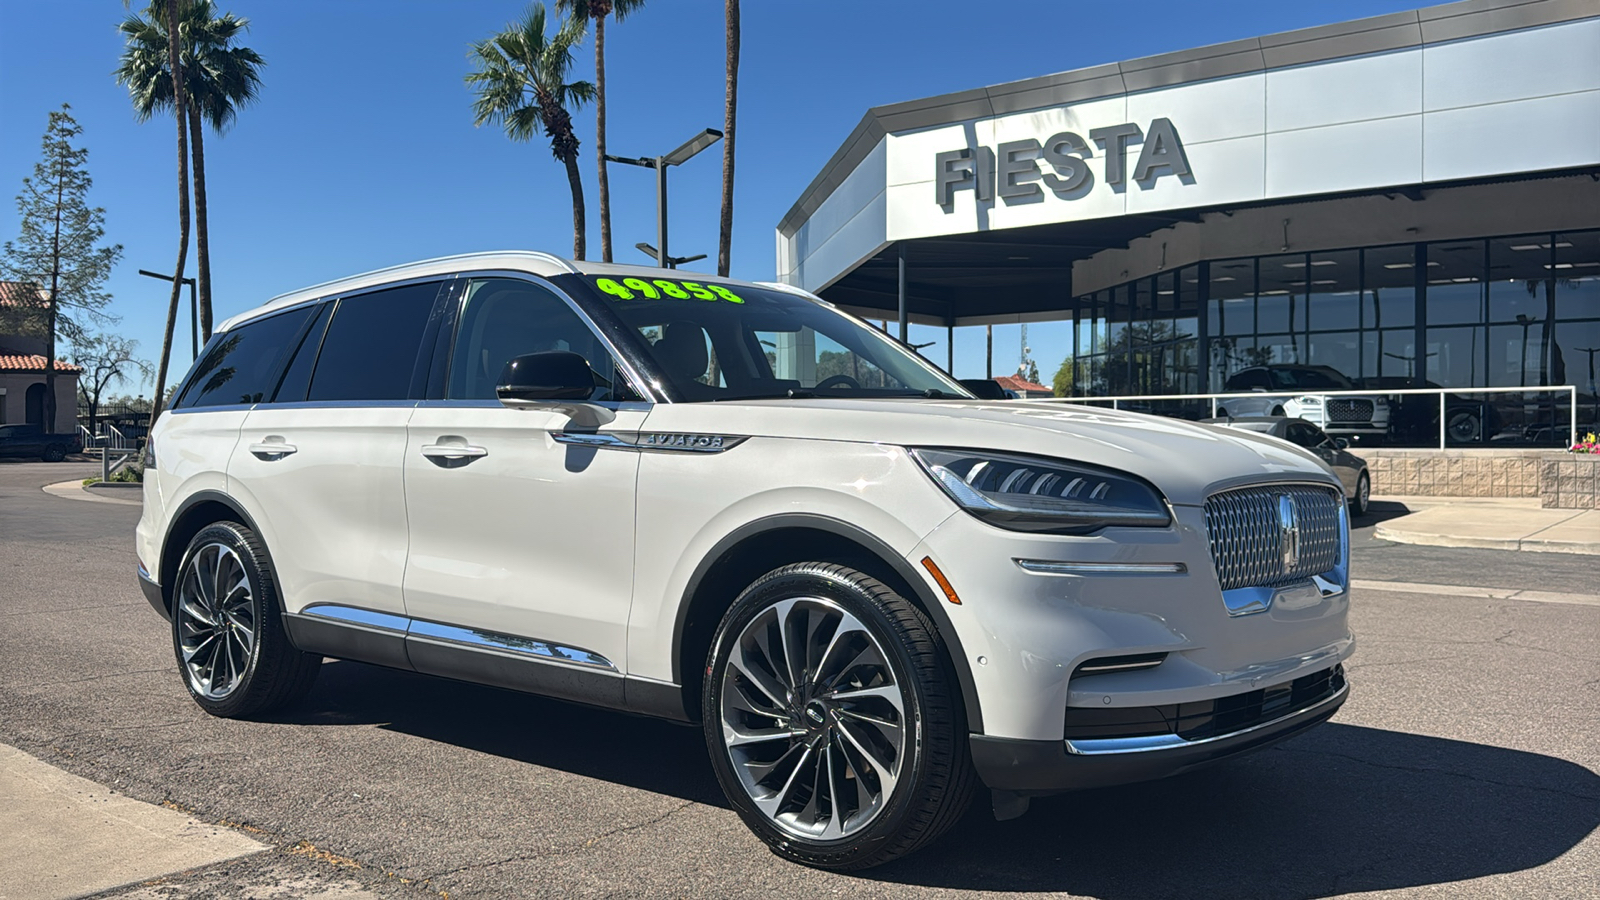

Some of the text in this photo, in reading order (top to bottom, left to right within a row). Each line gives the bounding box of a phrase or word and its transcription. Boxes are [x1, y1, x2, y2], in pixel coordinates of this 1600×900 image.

[936, 117, 1191, 203] FIESTA
[596, 278, 745, 304] 49858
[647, 434, 725, 448] AVIATOR
